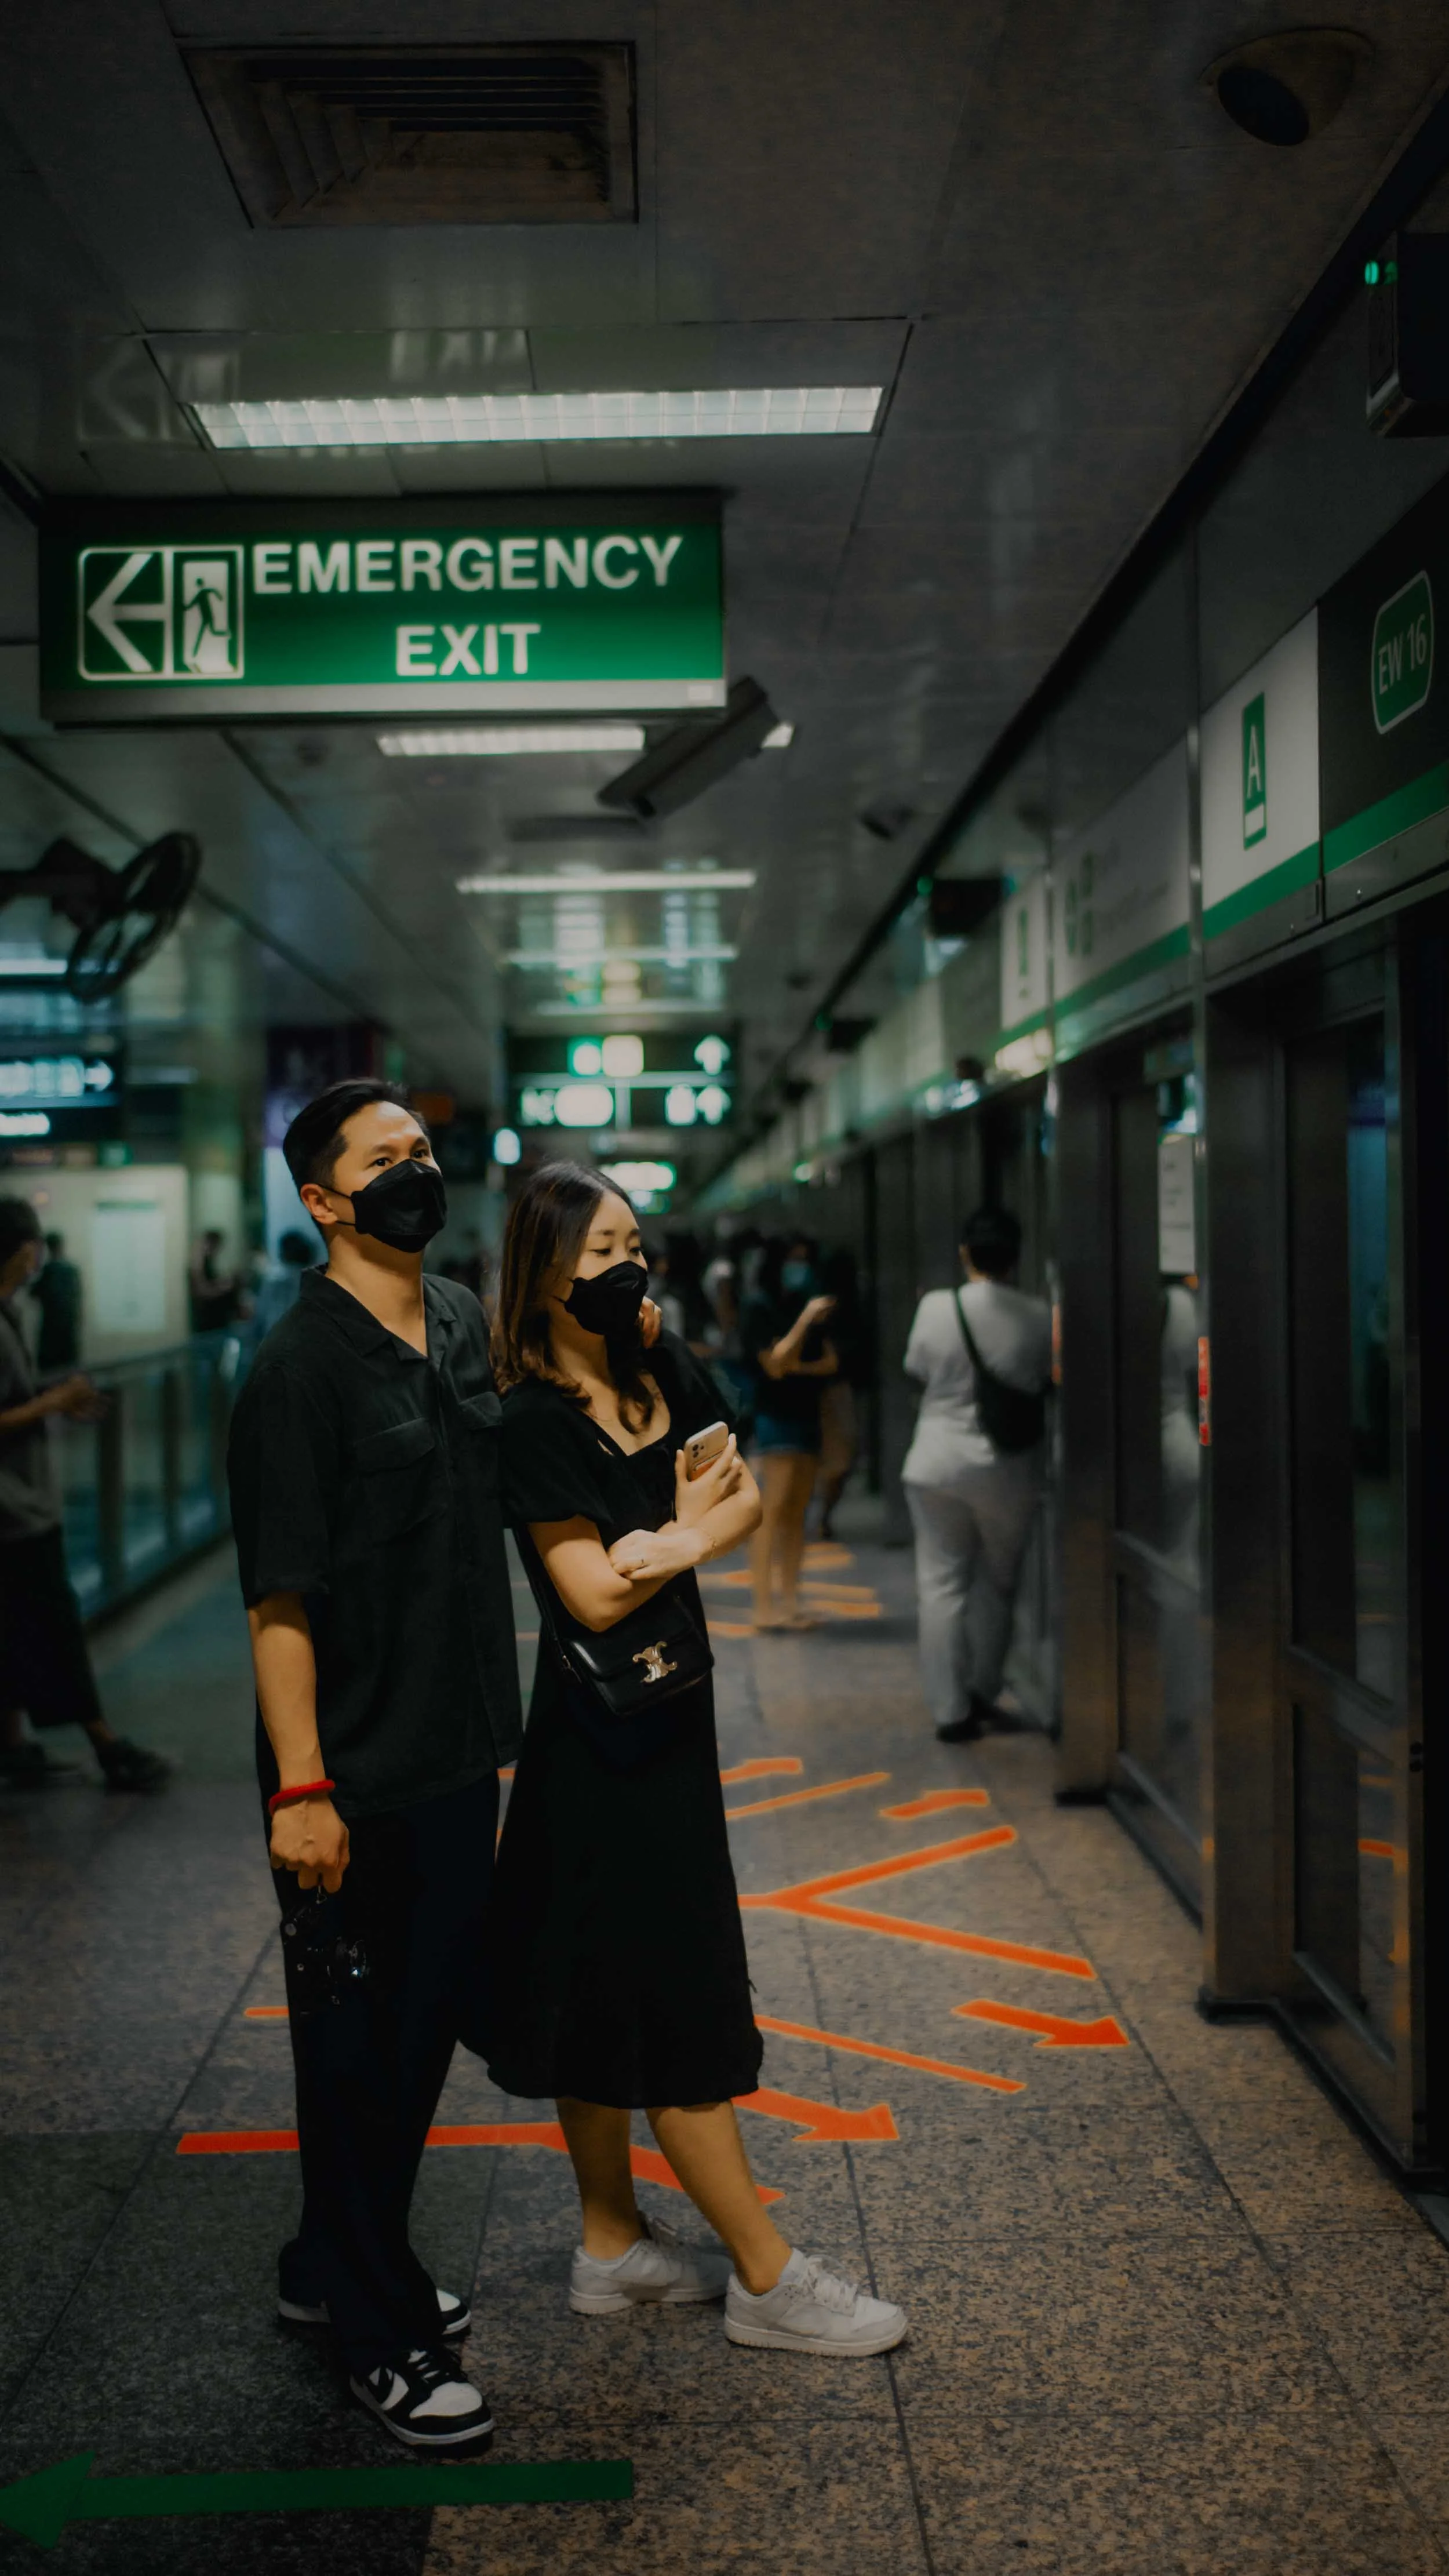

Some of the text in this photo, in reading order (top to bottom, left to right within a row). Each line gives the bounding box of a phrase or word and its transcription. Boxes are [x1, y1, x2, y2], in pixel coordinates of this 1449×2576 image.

[252, 534, 684, 594] EMERGENCY
[395, 622, 542, 677] EXIT
[1378, 613, 1428, 695] EW 16
[1247, 725, 1262, 799] A
